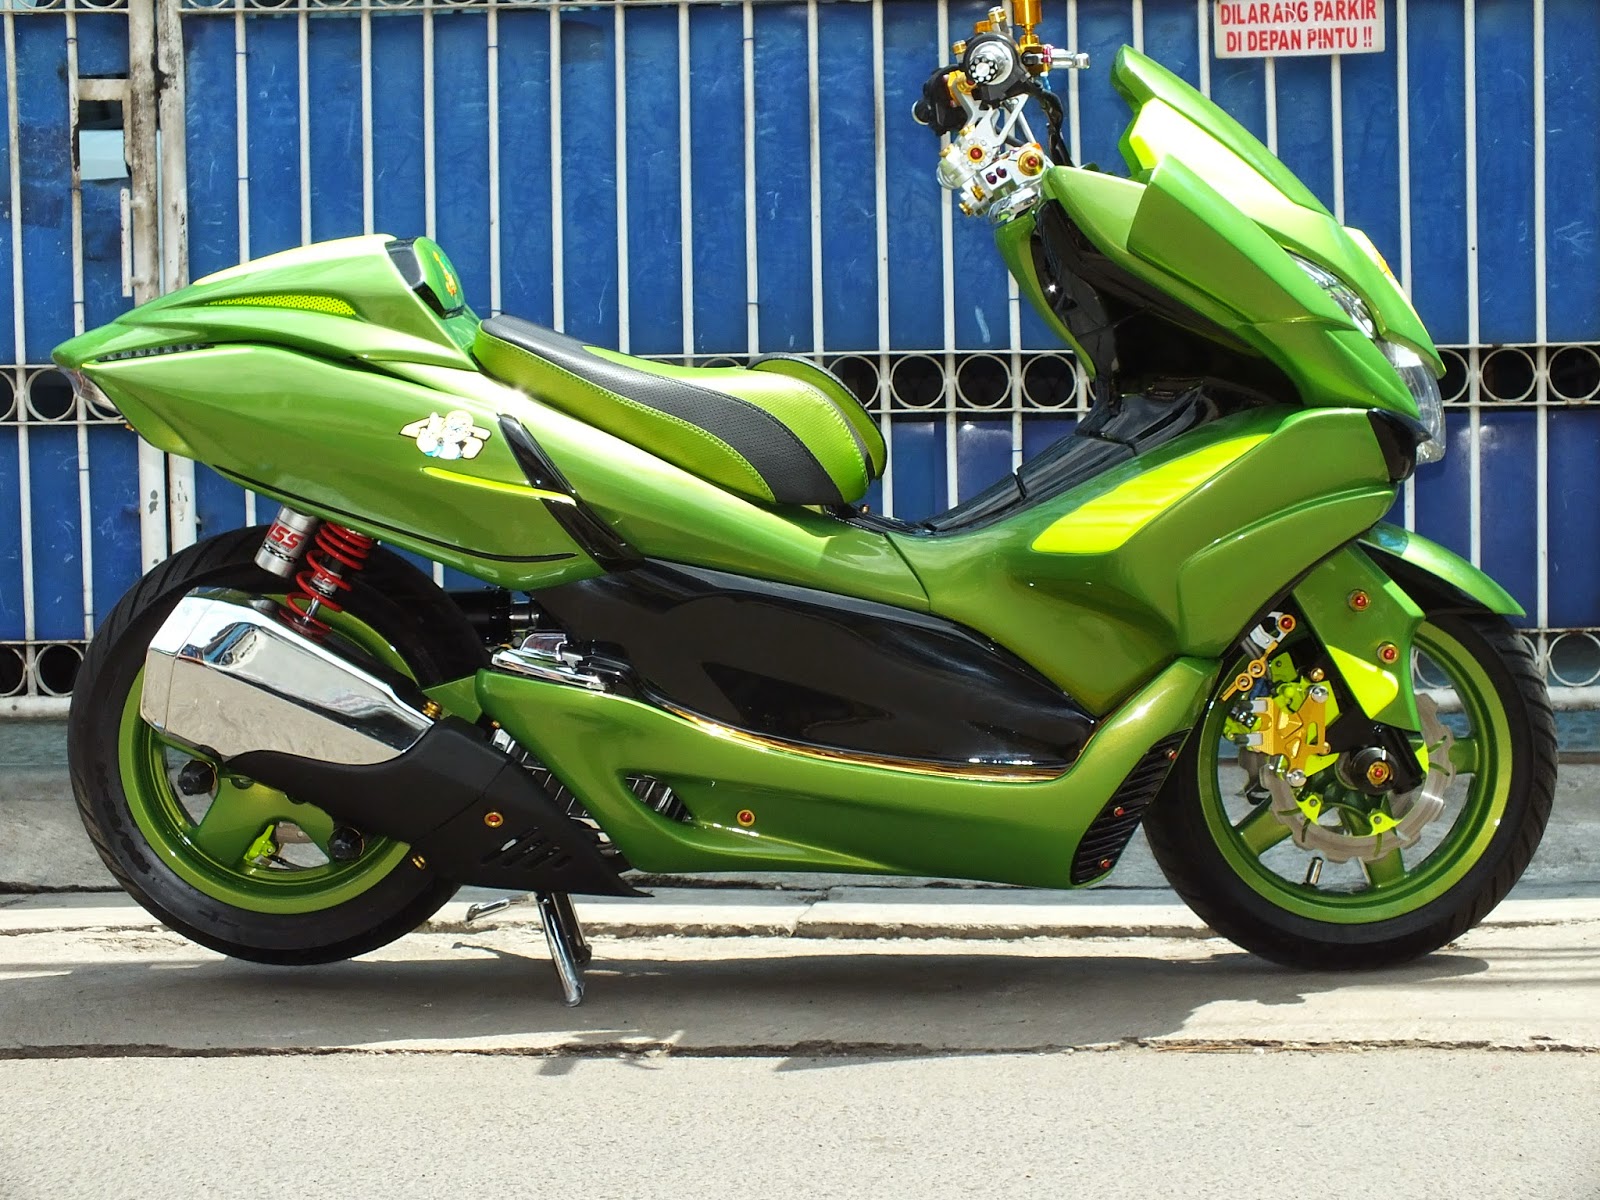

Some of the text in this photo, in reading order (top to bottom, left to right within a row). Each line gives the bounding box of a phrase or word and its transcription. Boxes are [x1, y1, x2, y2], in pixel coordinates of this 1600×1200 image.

[1221, 0, 1376, 25] DILARANG PARKIR
[1227, 31, 1242, 52] DI
[1248, 29, 1301, 51] DEPAN
[1307, 27, 1357, 49] PINTU
